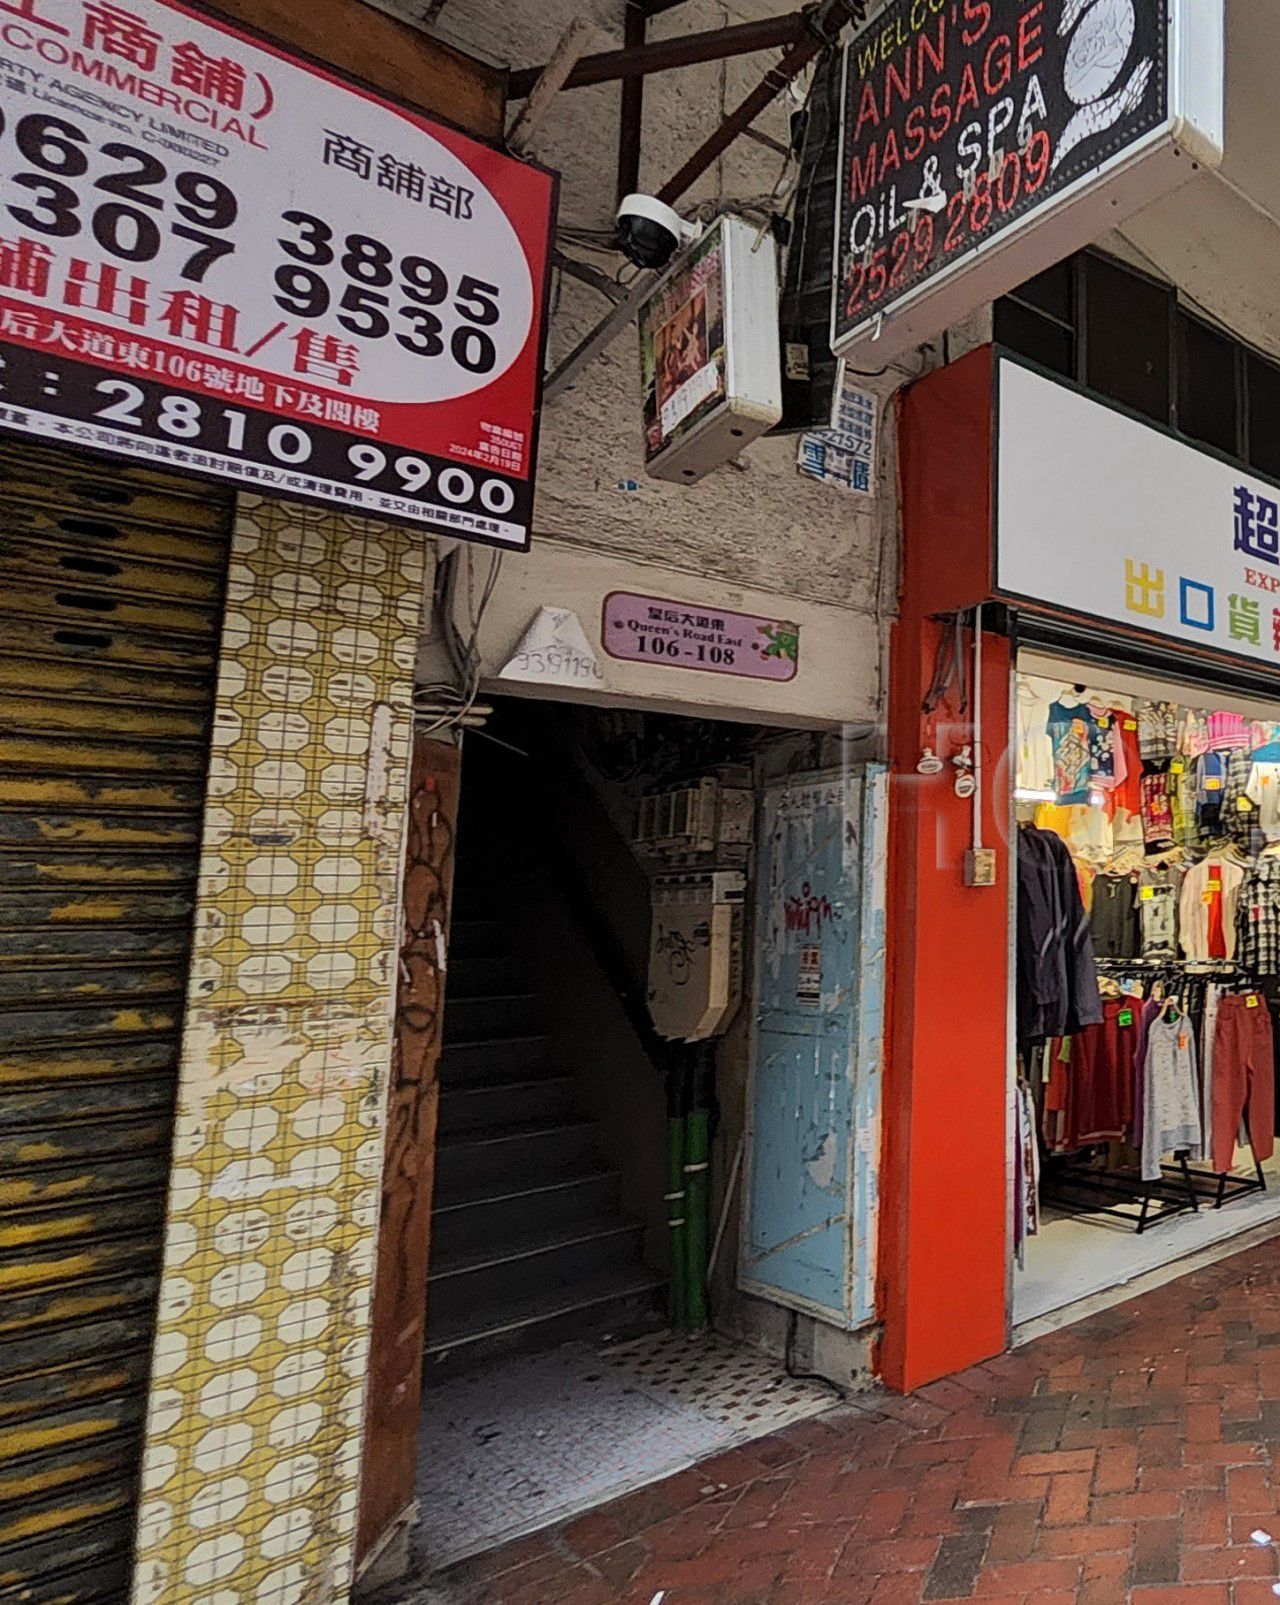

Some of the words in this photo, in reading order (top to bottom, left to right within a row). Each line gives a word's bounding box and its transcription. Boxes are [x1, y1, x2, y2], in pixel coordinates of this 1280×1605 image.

[2, 23, 268, 150] COMMERCIAL
[48, 79, 144, 123] AGENCY
[149, 117, 230, 158] LIMITED
[850, 0, 1044, 201] MASSAGE
[854, 0, 991, 142] ANN'S
[0, 100, 238, 230] 629
[322, 128, 476, 221] 商舖部
[918, 155, 942, 199] &
[956, 74, 1048, 180] SPA
[5, 172, 236, 284] 307
[279, 209, 501, 327] 3895
[846, 215, 935, 317] 2529
[944, 129, 1050, 251] 2809
[272, 263, 498, 375] 9530
[93, 379, 312, 464] 2810
[347, 444, 515, 514] 9900
[627, 619, 680, 638] Queen's
[683, 628, 714, 644] Road
[717, 634, 743, 649] East
[647, 605, 726, 632] 皇后大道東
